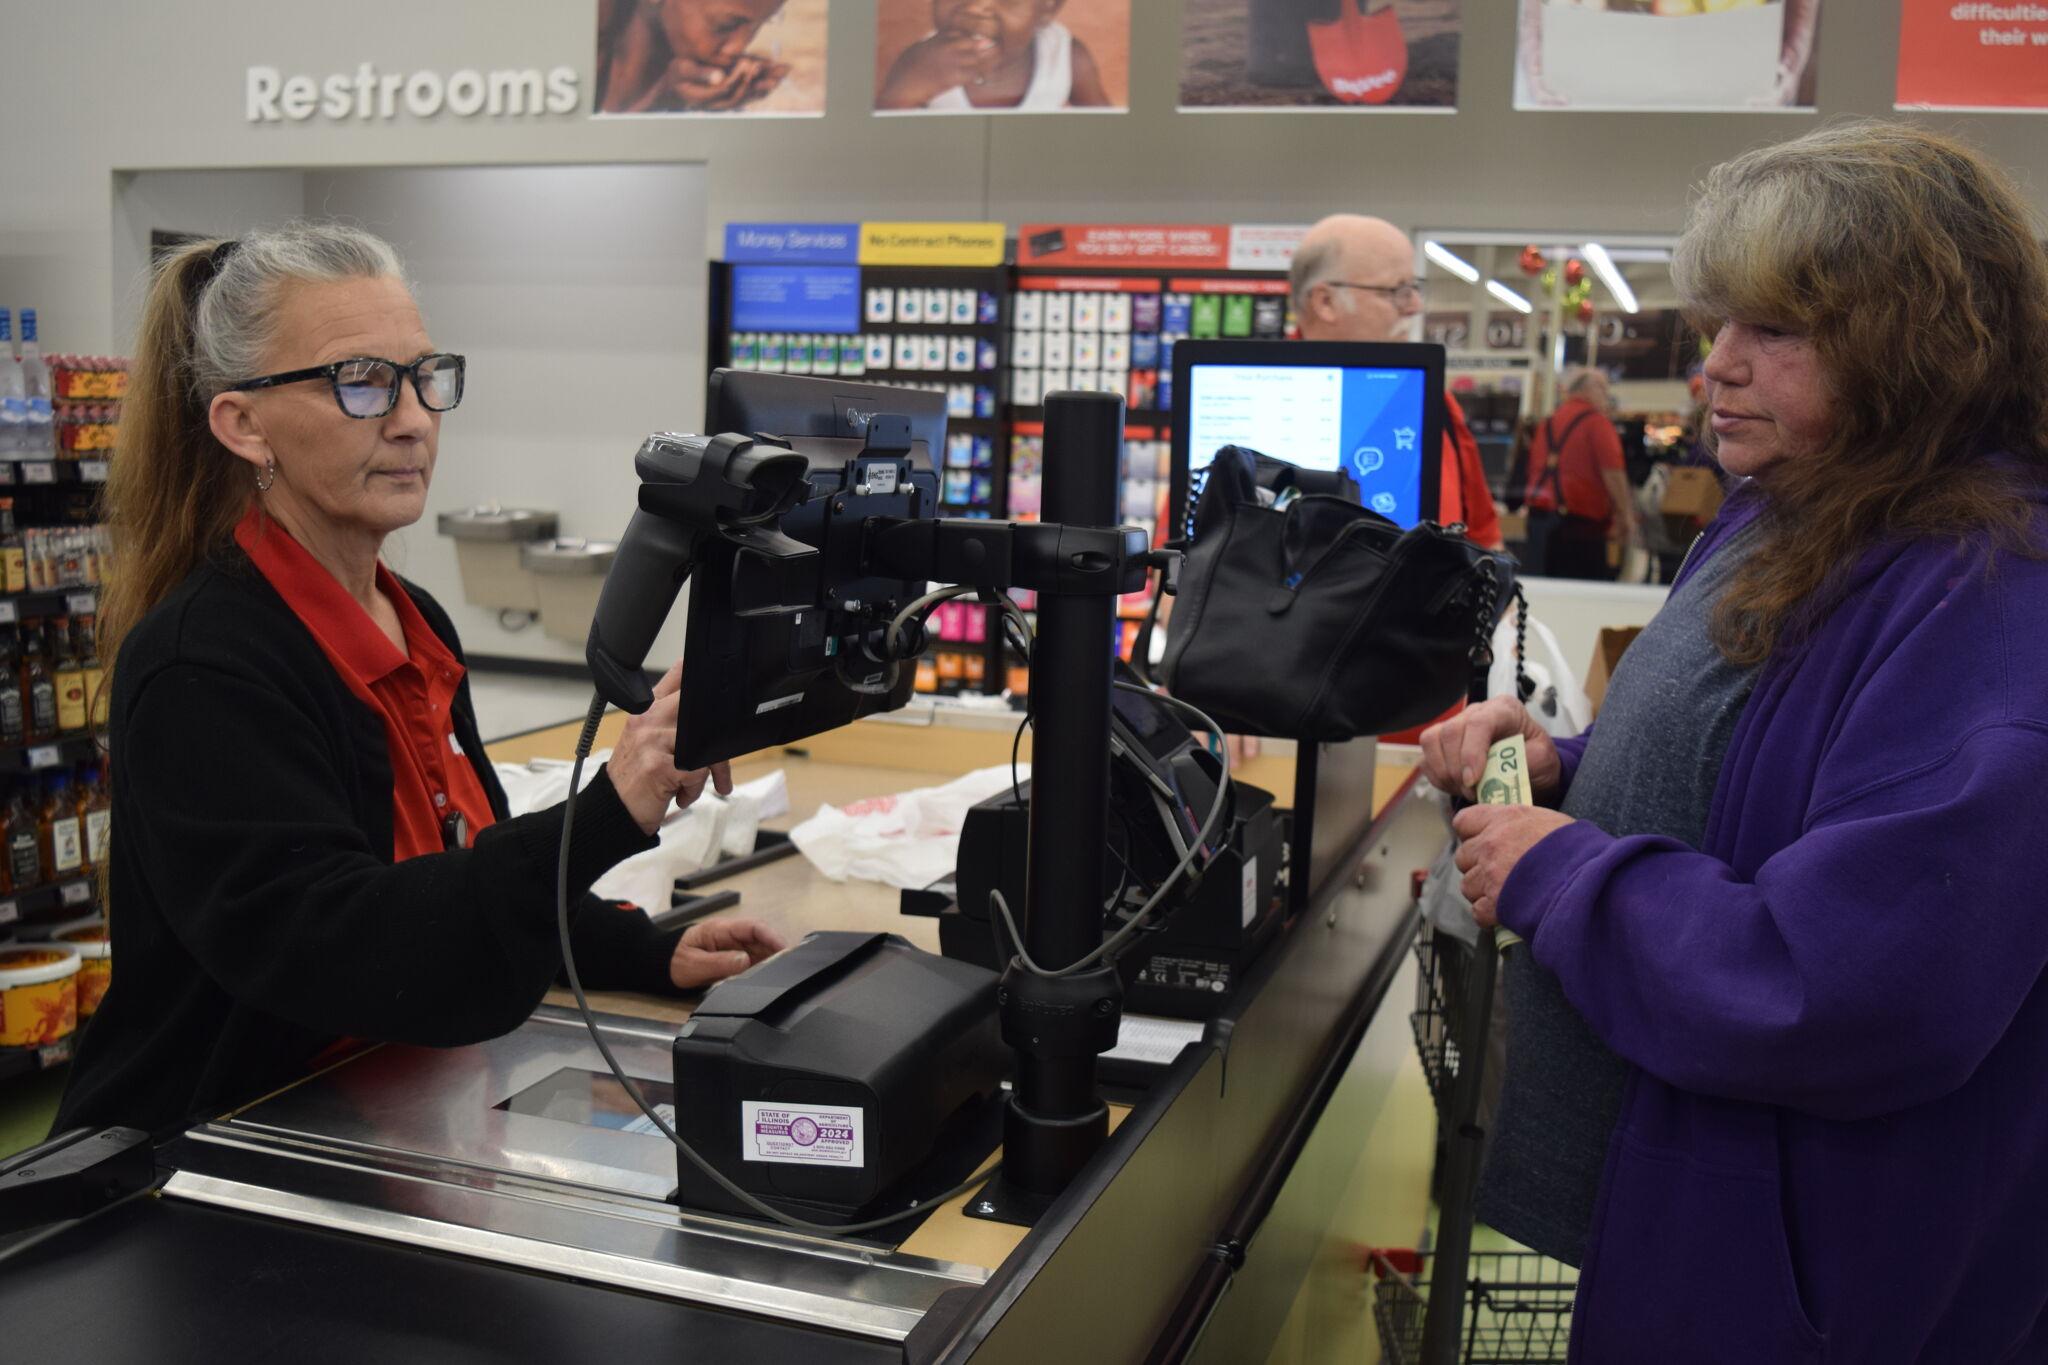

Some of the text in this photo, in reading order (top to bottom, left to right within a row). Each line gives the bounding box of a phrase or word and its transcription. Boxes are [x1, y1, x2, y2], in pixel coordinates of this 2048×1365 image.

[1950, 2, 2048, 20] difficultie
[1980, 28, 2026, 46] their
[247, 62, 579, 121] Restrooms
[737, 230, 847, 251] Money Services
[869, 234, 996, 249] No Contract Phones
[1499, 746, 1518, 773] 20
[820, 1128, 848, 1138] 2024
